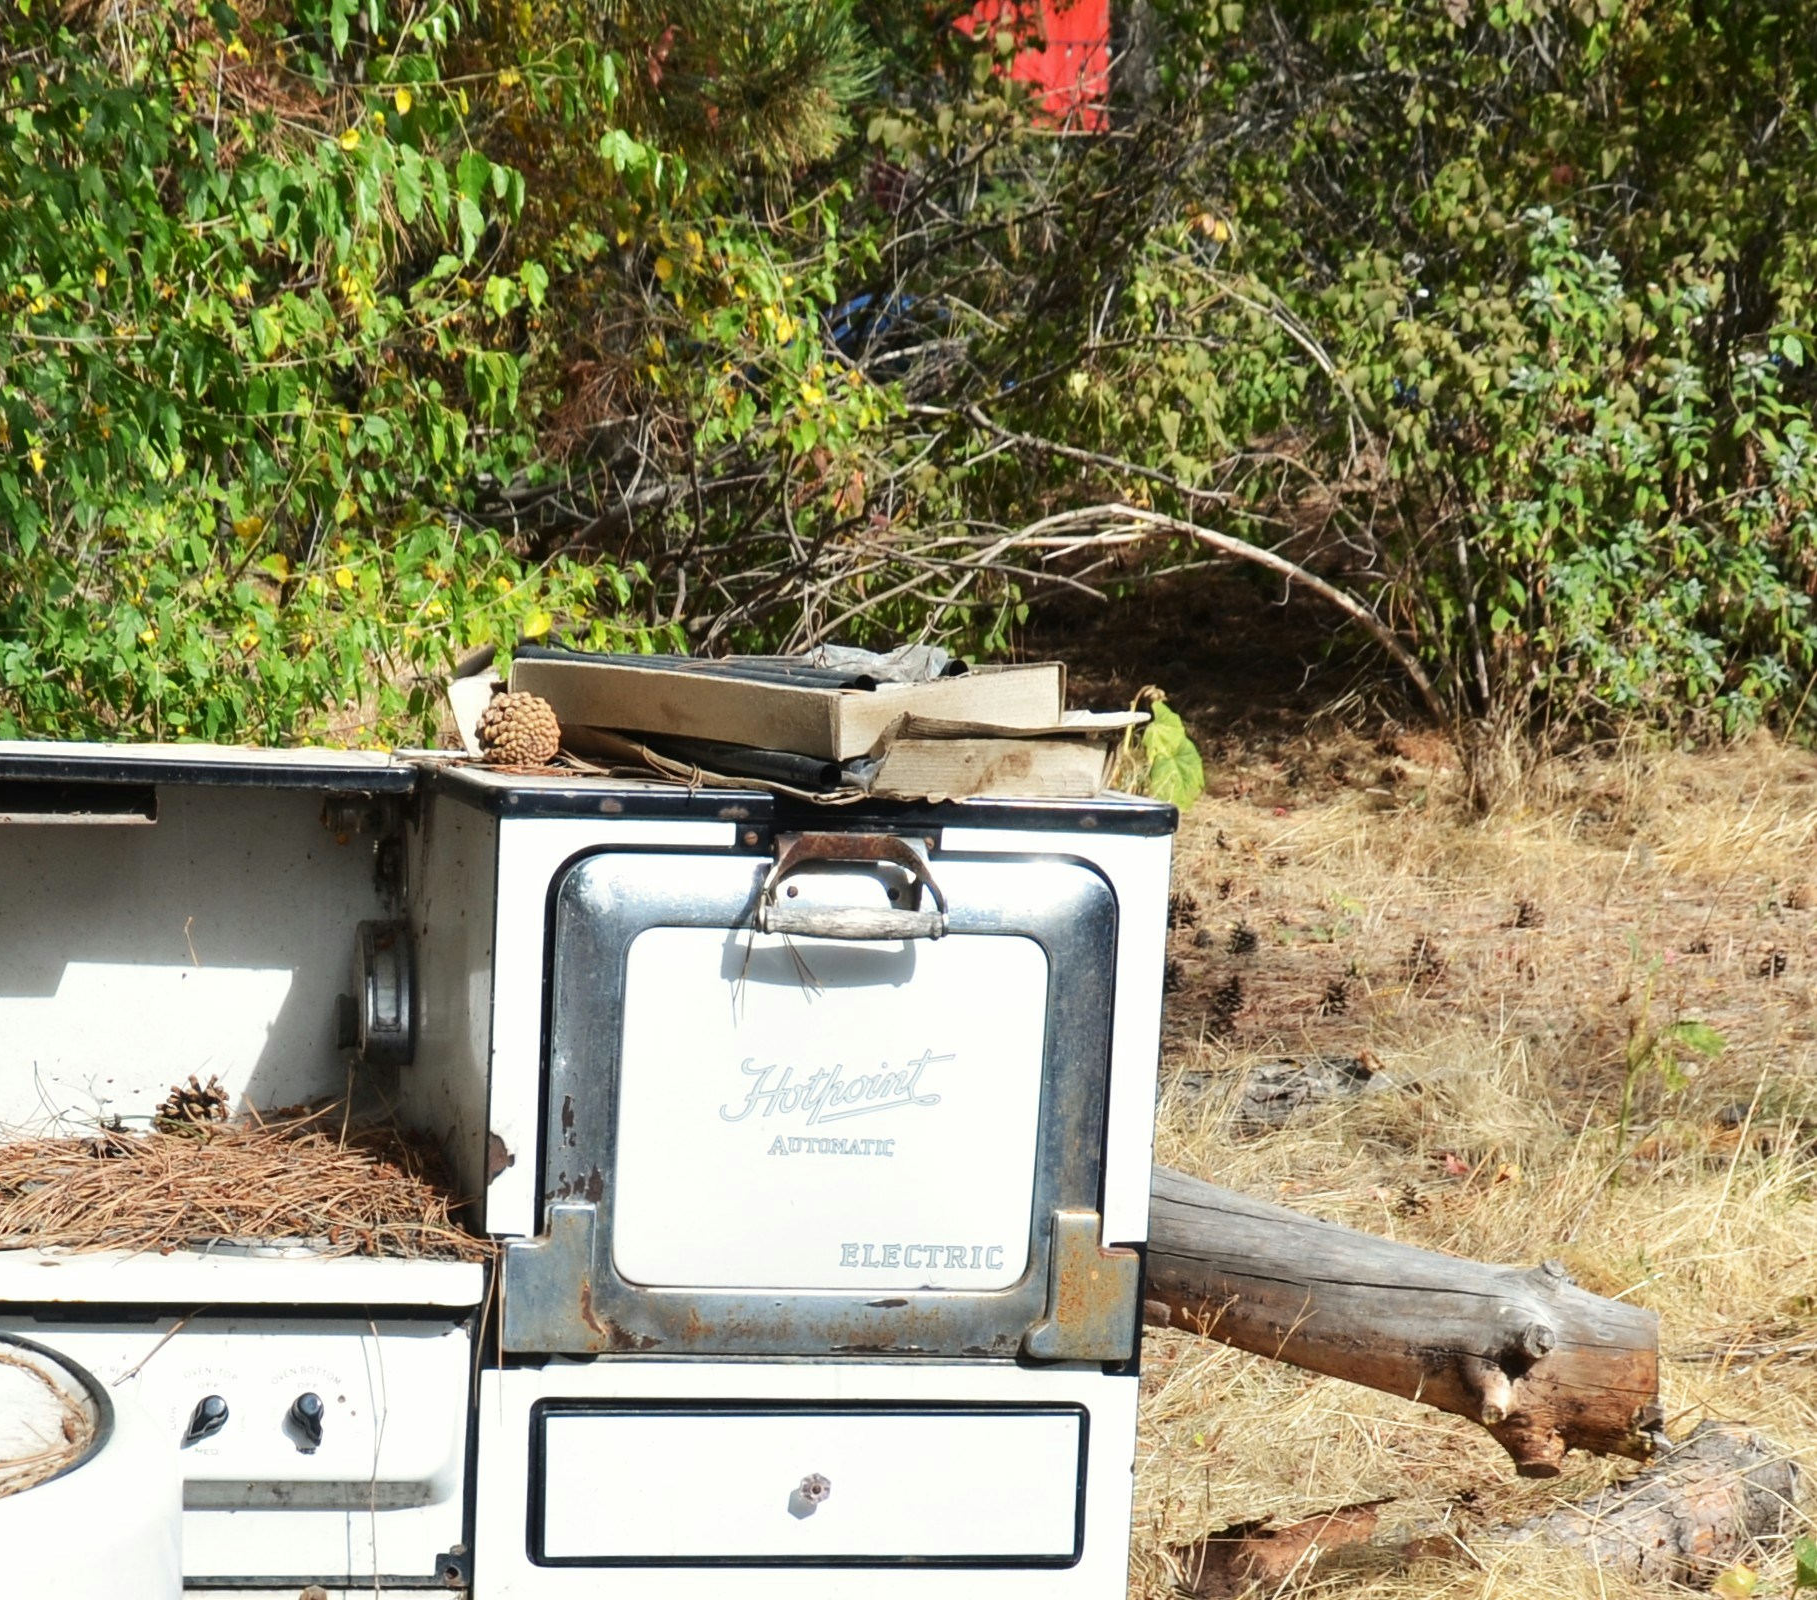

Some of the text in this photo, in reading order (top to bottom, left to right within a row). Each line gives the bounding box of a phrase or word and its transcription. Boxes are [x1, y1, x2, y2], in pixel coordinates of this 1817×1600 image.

[719, 1048, 956, 1126] Hotpoint
[767, 1134, 896, 1157] AUTOMATIC
[839, 1243, 1005, 1270] ELECTRIC
[183, 1366, 212, 1379] OVEN
[270, 1365, 342, 1386] OVEN BOTTOM
